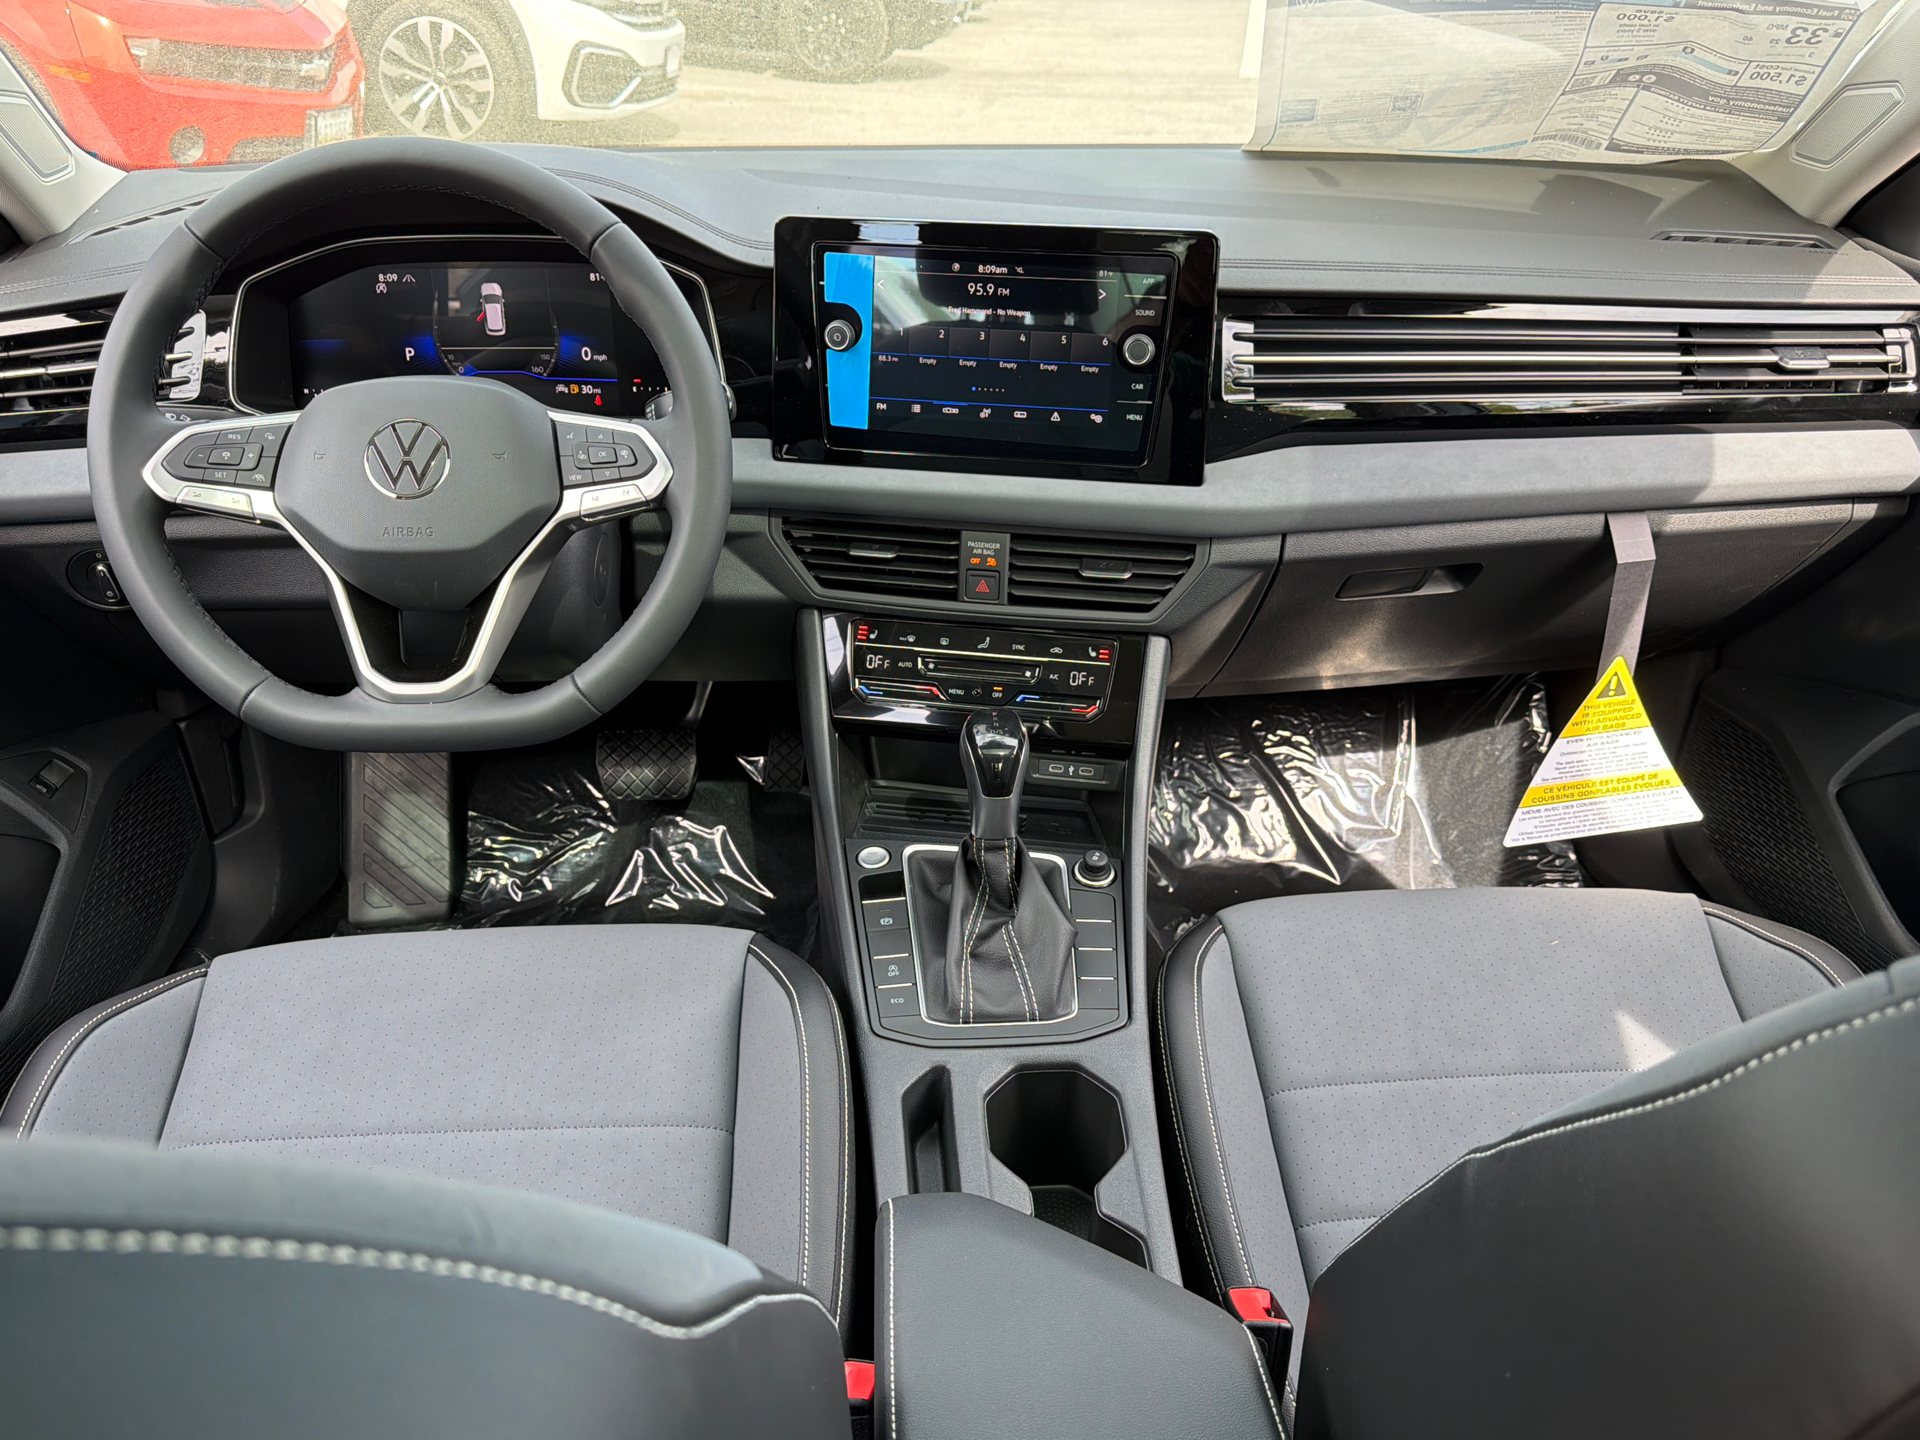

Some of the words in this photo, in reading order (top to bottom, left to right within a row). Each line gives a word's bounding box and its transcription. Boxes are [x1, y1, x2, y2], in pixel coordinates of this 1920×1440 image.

[978, 265, 1008, 274] 8:09am
[378, 273, 398, 282] 8:09
[967, 283, 995, 297] 95.9
[998, 287, 1010, 297] FM
[1134, 309, 1155, 317] SOUND
[899, 327, 904, 336] 1
[938, 330, 945, 339] 2
[979, 331, 985, 341] 3
[1019, 333, 1026, 343] 4
[1061, 335, 1067, 345] 5
[1102, 336, 1108, 346] 6
[404, 347, 415, 361] P
[581, 347, 591, 361] 0
[593, 354, 608, 362] mph
[878, 354, 891, 362] 88.3
[919, 356, 937, 366] Empty
[959, 359, 977, 368] Empty
[999, 361, 1017, 370] Empty
[1040, 363, 1058, 372] Empty
[1081, 365, 1099, 374] Empty
[581, 385, 593, 394] 30
[1131, 382, 1144, 390] CAR
[876, 403, 887, 411] FM
[382, 527, 434, 537] AIRBAG
[967, 541, 1000, 549] PASSENGER
[948, 688, 964, 696] MENU
[1583, 703, 1601, 711] THIS
[1603, 699, 1636, 709] VEHICLE
[1592, 707, 1634, 718] EQUIPPED
[1571, 720, 1594, 728] WITH
[1595, 713, 1642, 724] ADVANCED
[1585, 725, 1600, 733] AIR
[1602, 722, 1626, 731] BAGS
[1606, 730, 1642, 739] ADVANCED
[1556, 781, 1597, 793] VÉHICULE
[1599, 779, 1614, 787] EST
[1531, 792, 1575, 803] COUSSINS
[1578, 784, 1632, 797] GONFLABLES
